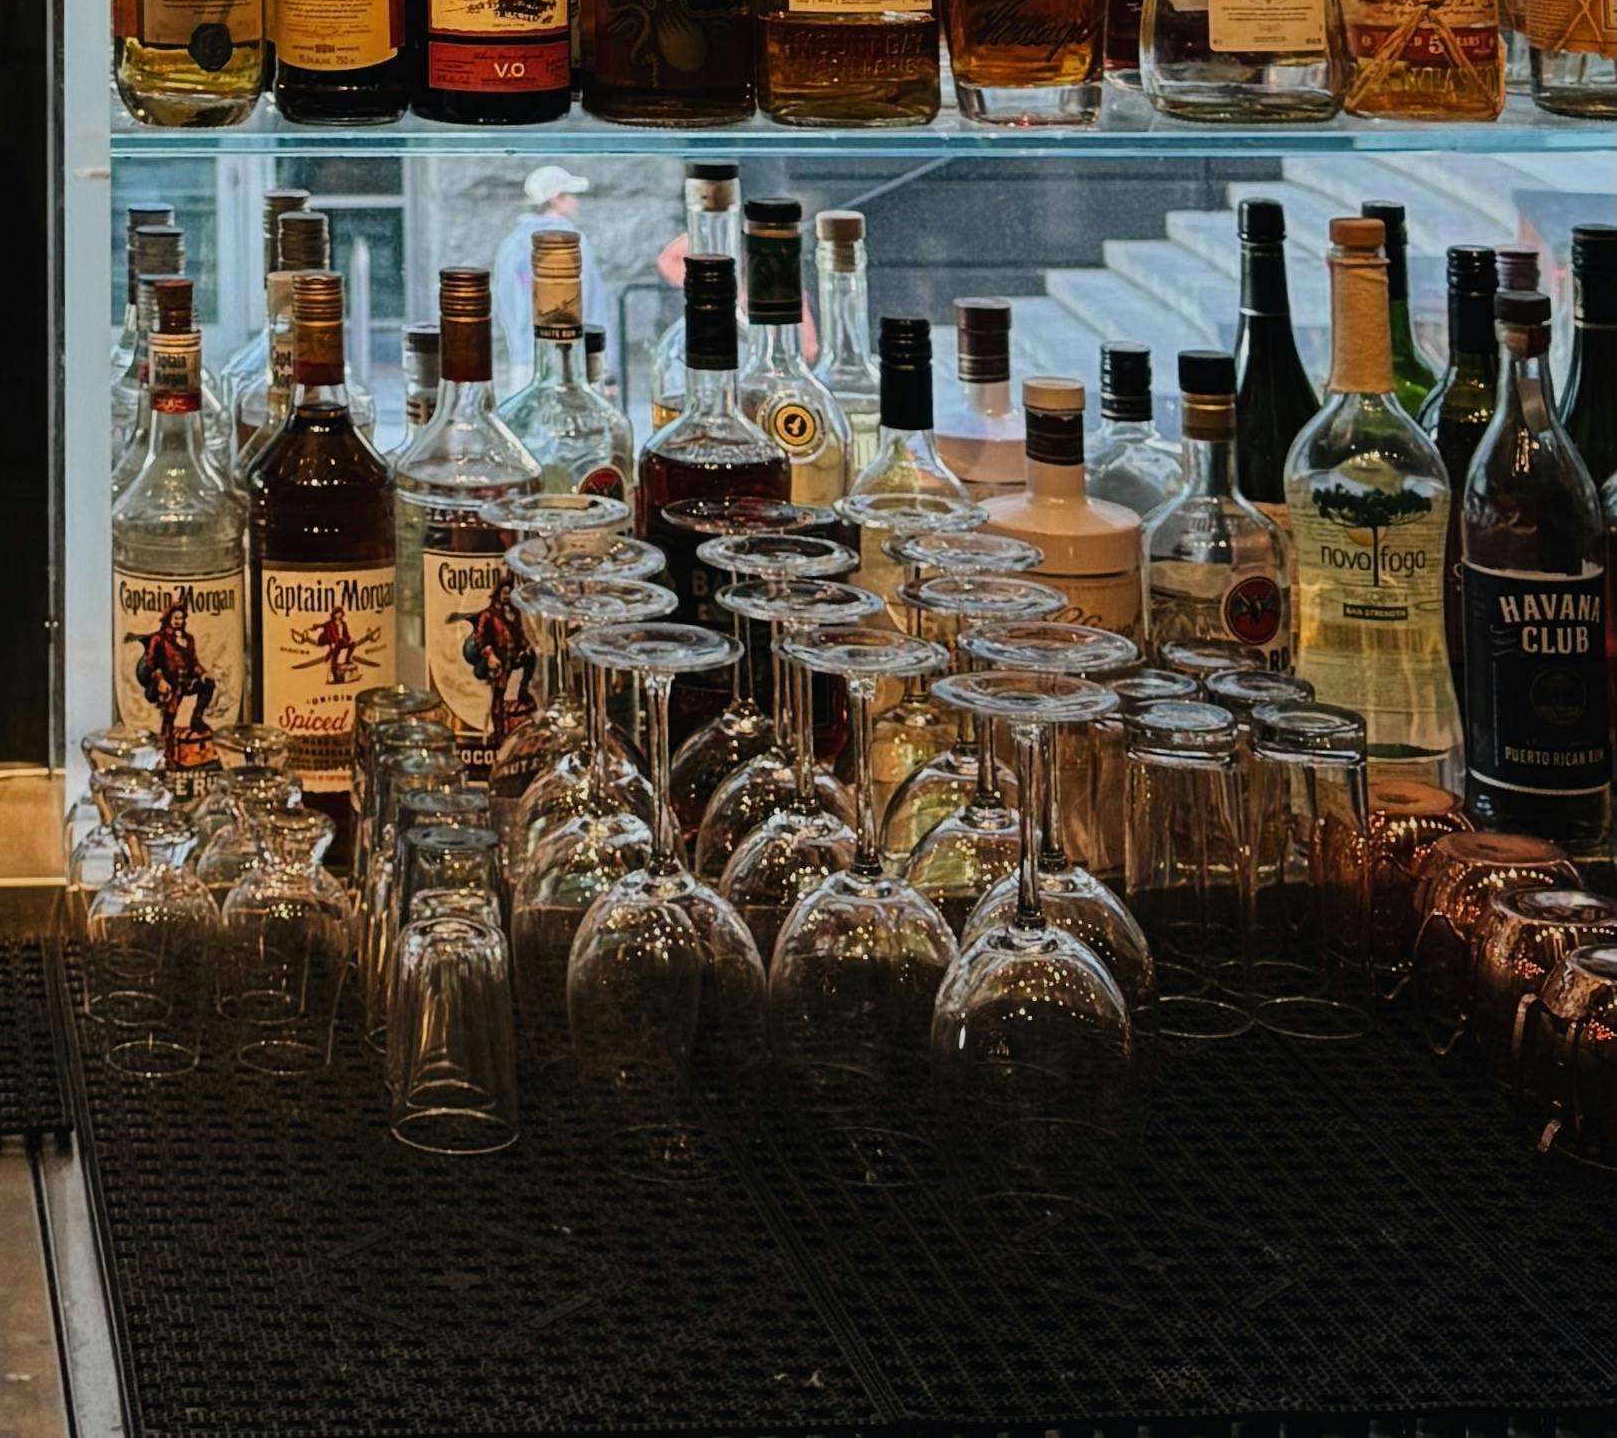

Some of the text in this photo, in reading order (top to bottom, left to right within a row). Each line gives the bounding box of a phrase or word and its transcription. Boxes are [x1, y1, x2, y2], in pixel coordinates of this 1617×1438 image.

[1321, 542, 1426, 577] novo fogo
[438, 561, 502, 592] Captain
[119, 579, 236, 616] Captain Morgan
[266, 578, 394, 616] Captain Morgan
[1499, 593, 1600, 625] HAVANA
[1521, 625, 1590, 654] CLUB
[279, 705, 349, 733] Spiced
